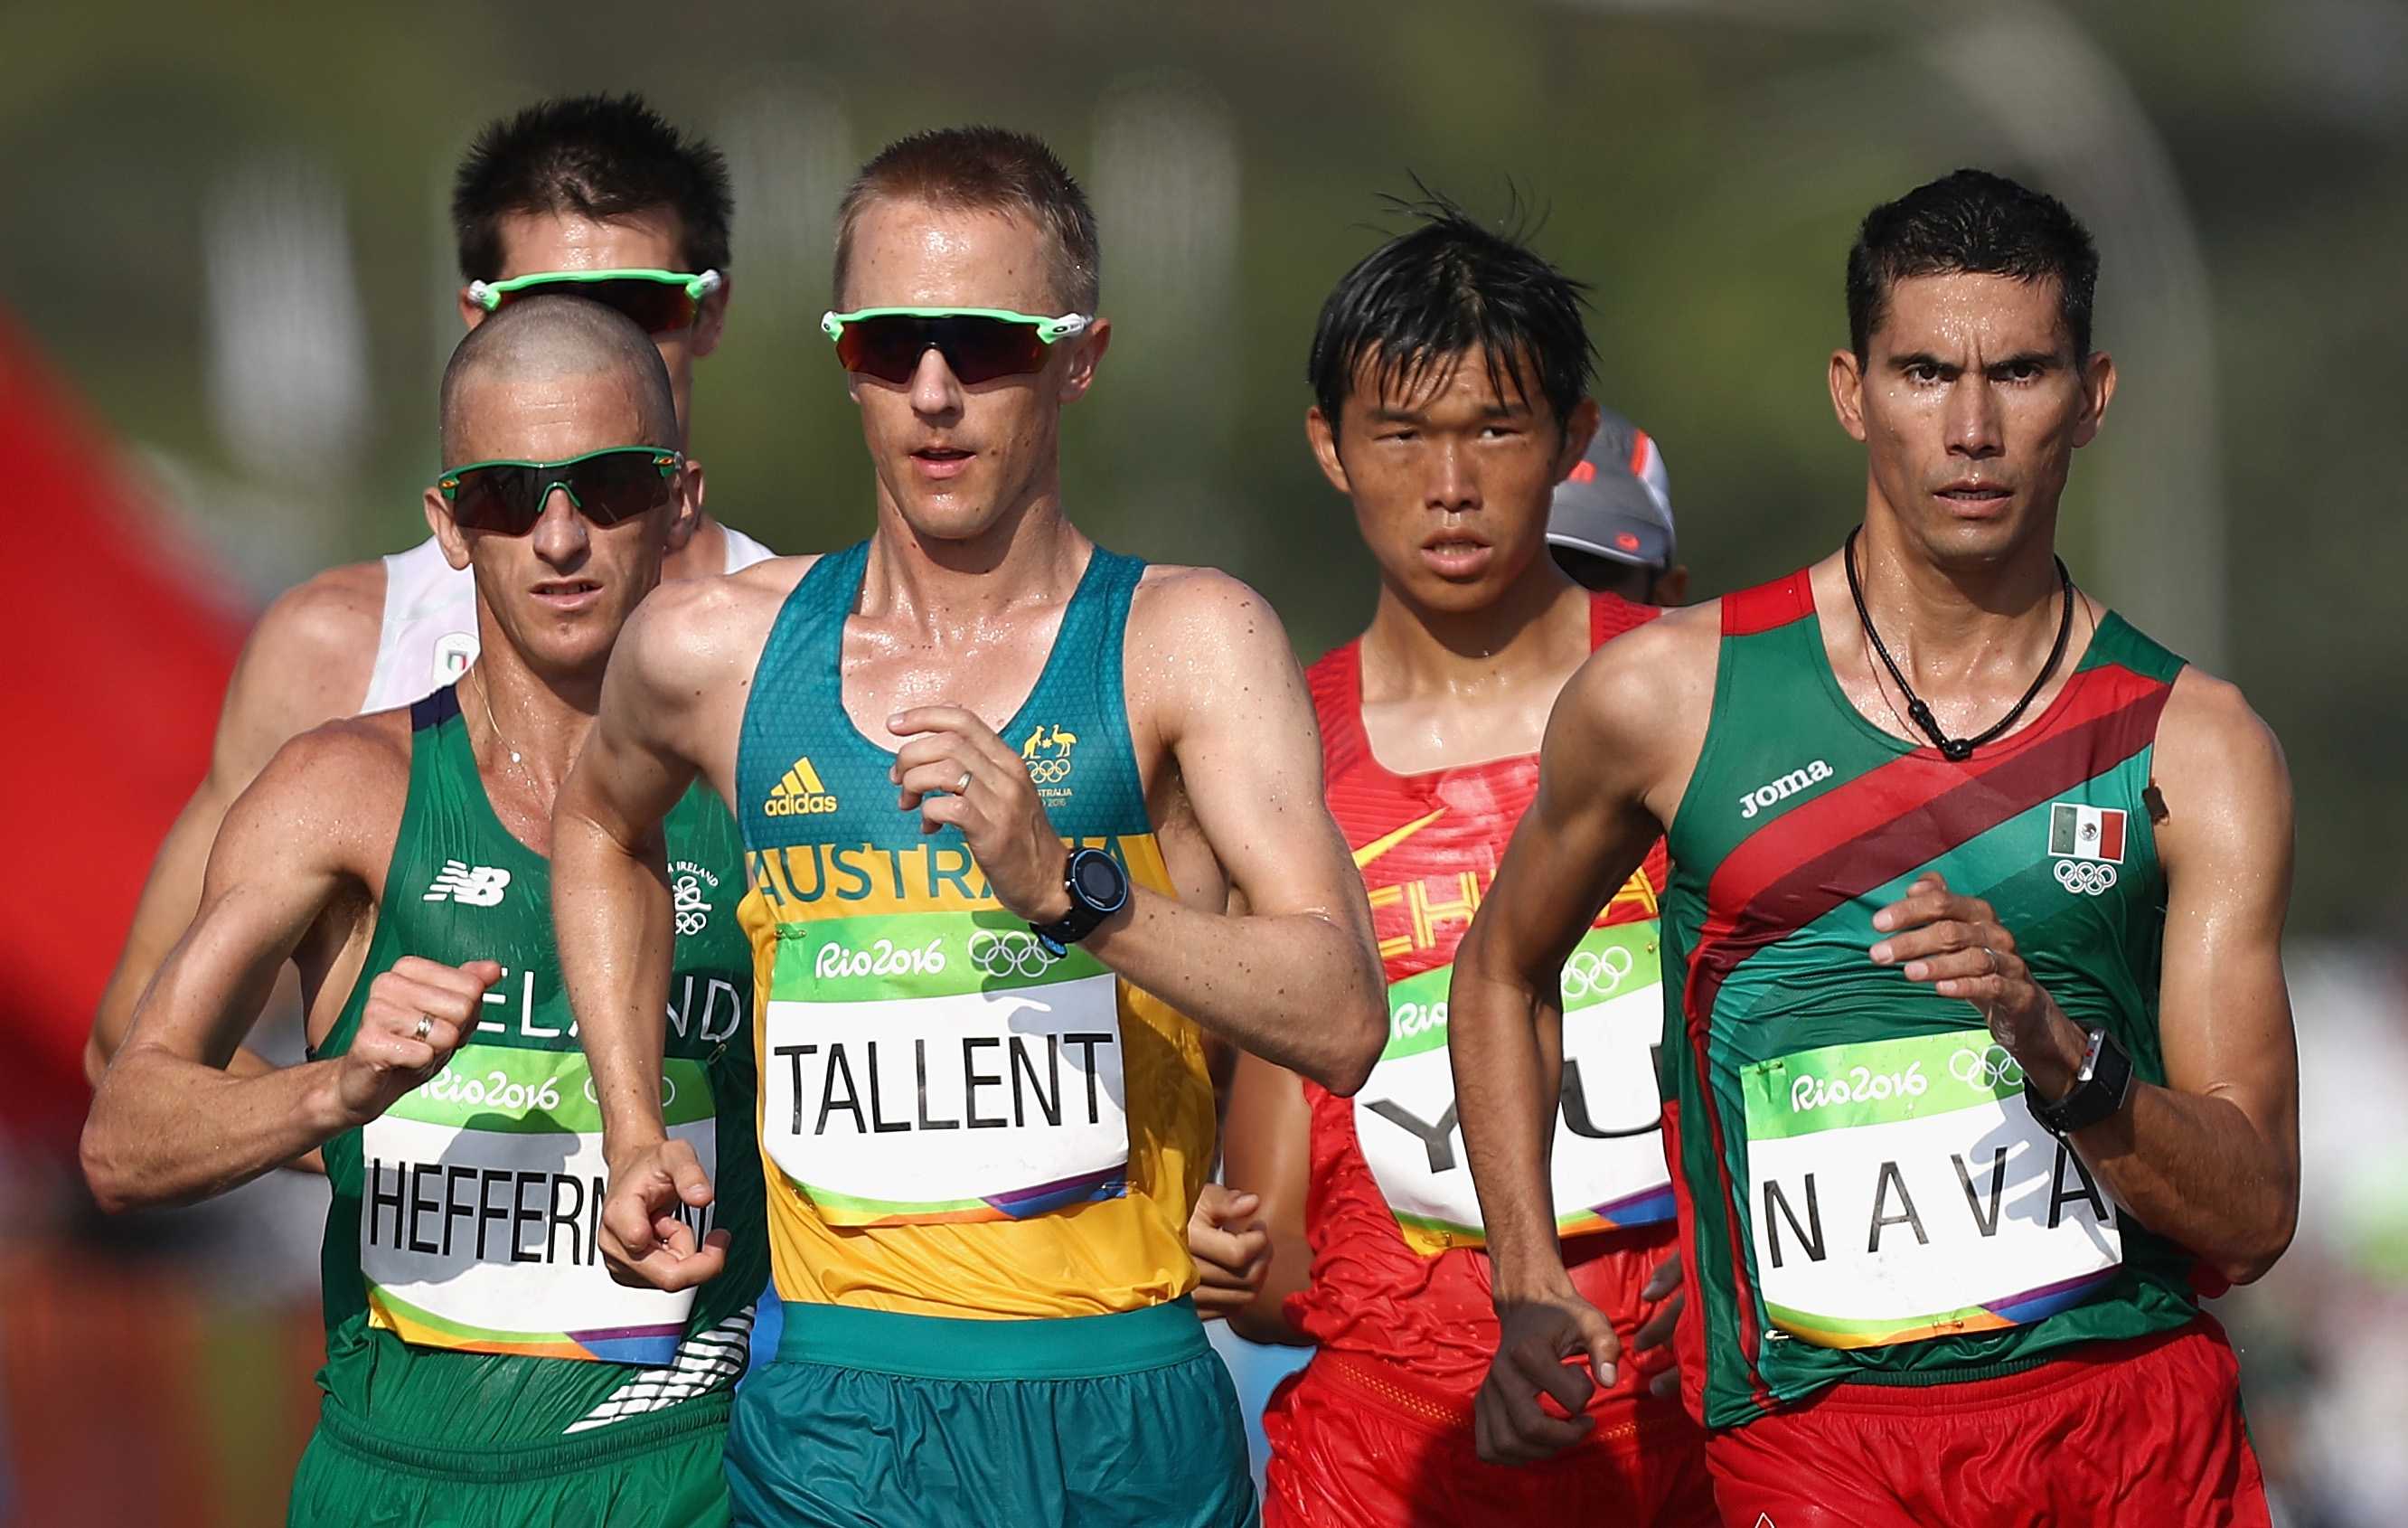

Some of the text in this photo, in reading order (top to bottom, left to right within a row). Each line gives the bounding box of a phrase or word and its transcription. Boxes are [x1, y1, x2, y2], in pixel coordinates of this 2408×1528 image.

[765, 791, 837, 816] adidas
[1739, 759, 1834, 818] Joma
[676, 861, 720, 887] IRELAND
[814, 937, 946, 978] Rio2016
[419, 1065, 561, 1111] Rio2016
[774, 1033, 1114, 1136] TALLENT
[1791, 1061, 1928, 1113] Rio2016
[1763, 1137, 2110, 1269] NAVA
